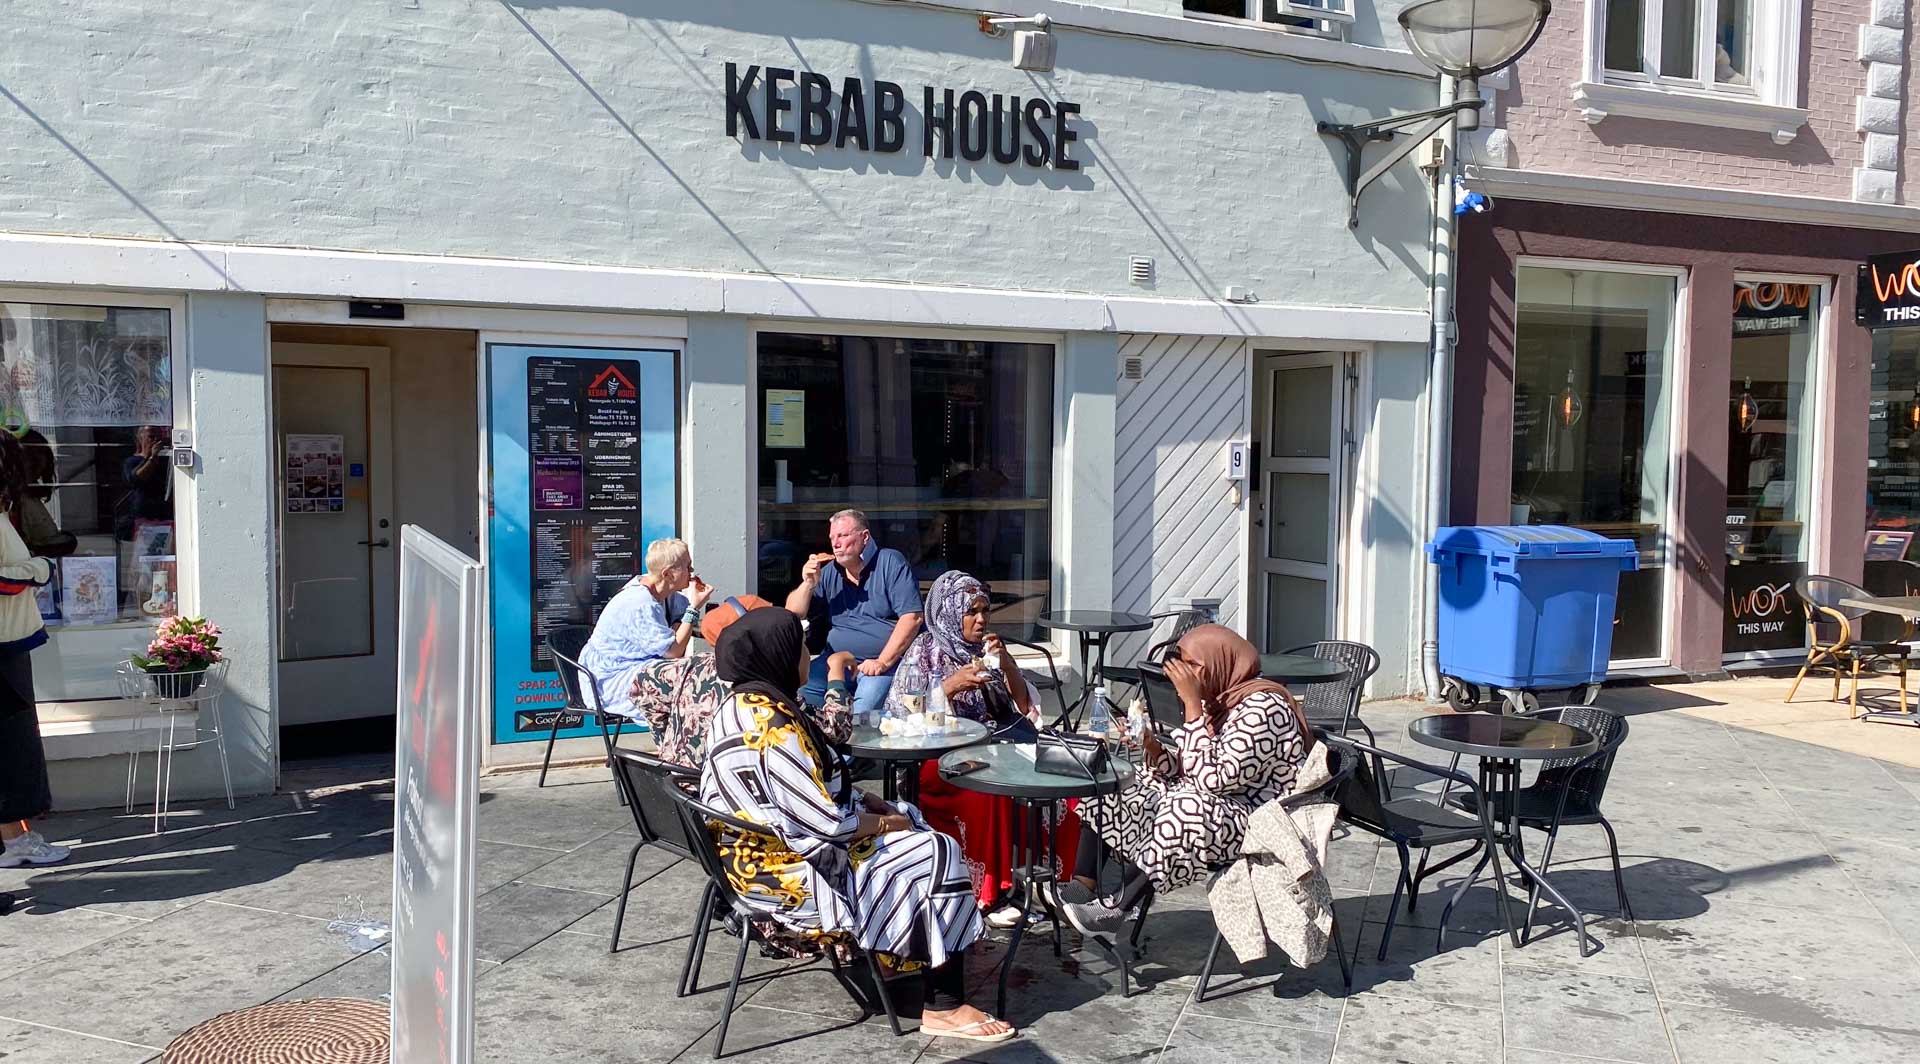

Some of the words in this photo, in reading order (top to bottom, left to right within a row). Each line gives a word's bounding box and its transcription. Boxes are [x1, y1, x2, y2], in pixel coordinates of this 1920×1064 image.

[724, 62, 904, 153] KEBAB
[923, 85, 1081, 171] HOUSE
[1883, 306, 1920, 321] THIS
[1234, 451, 1241, 467] 9
[1737, 622, 1760, 635] THIS
[1761, 621, 1784, 633] WAY
[519, 680, 546, 690] SPAR
[549, 679, 563, 688] 20
[515, 693, 565, 704] DOWNLO
[565, 714, 582, 724] play
